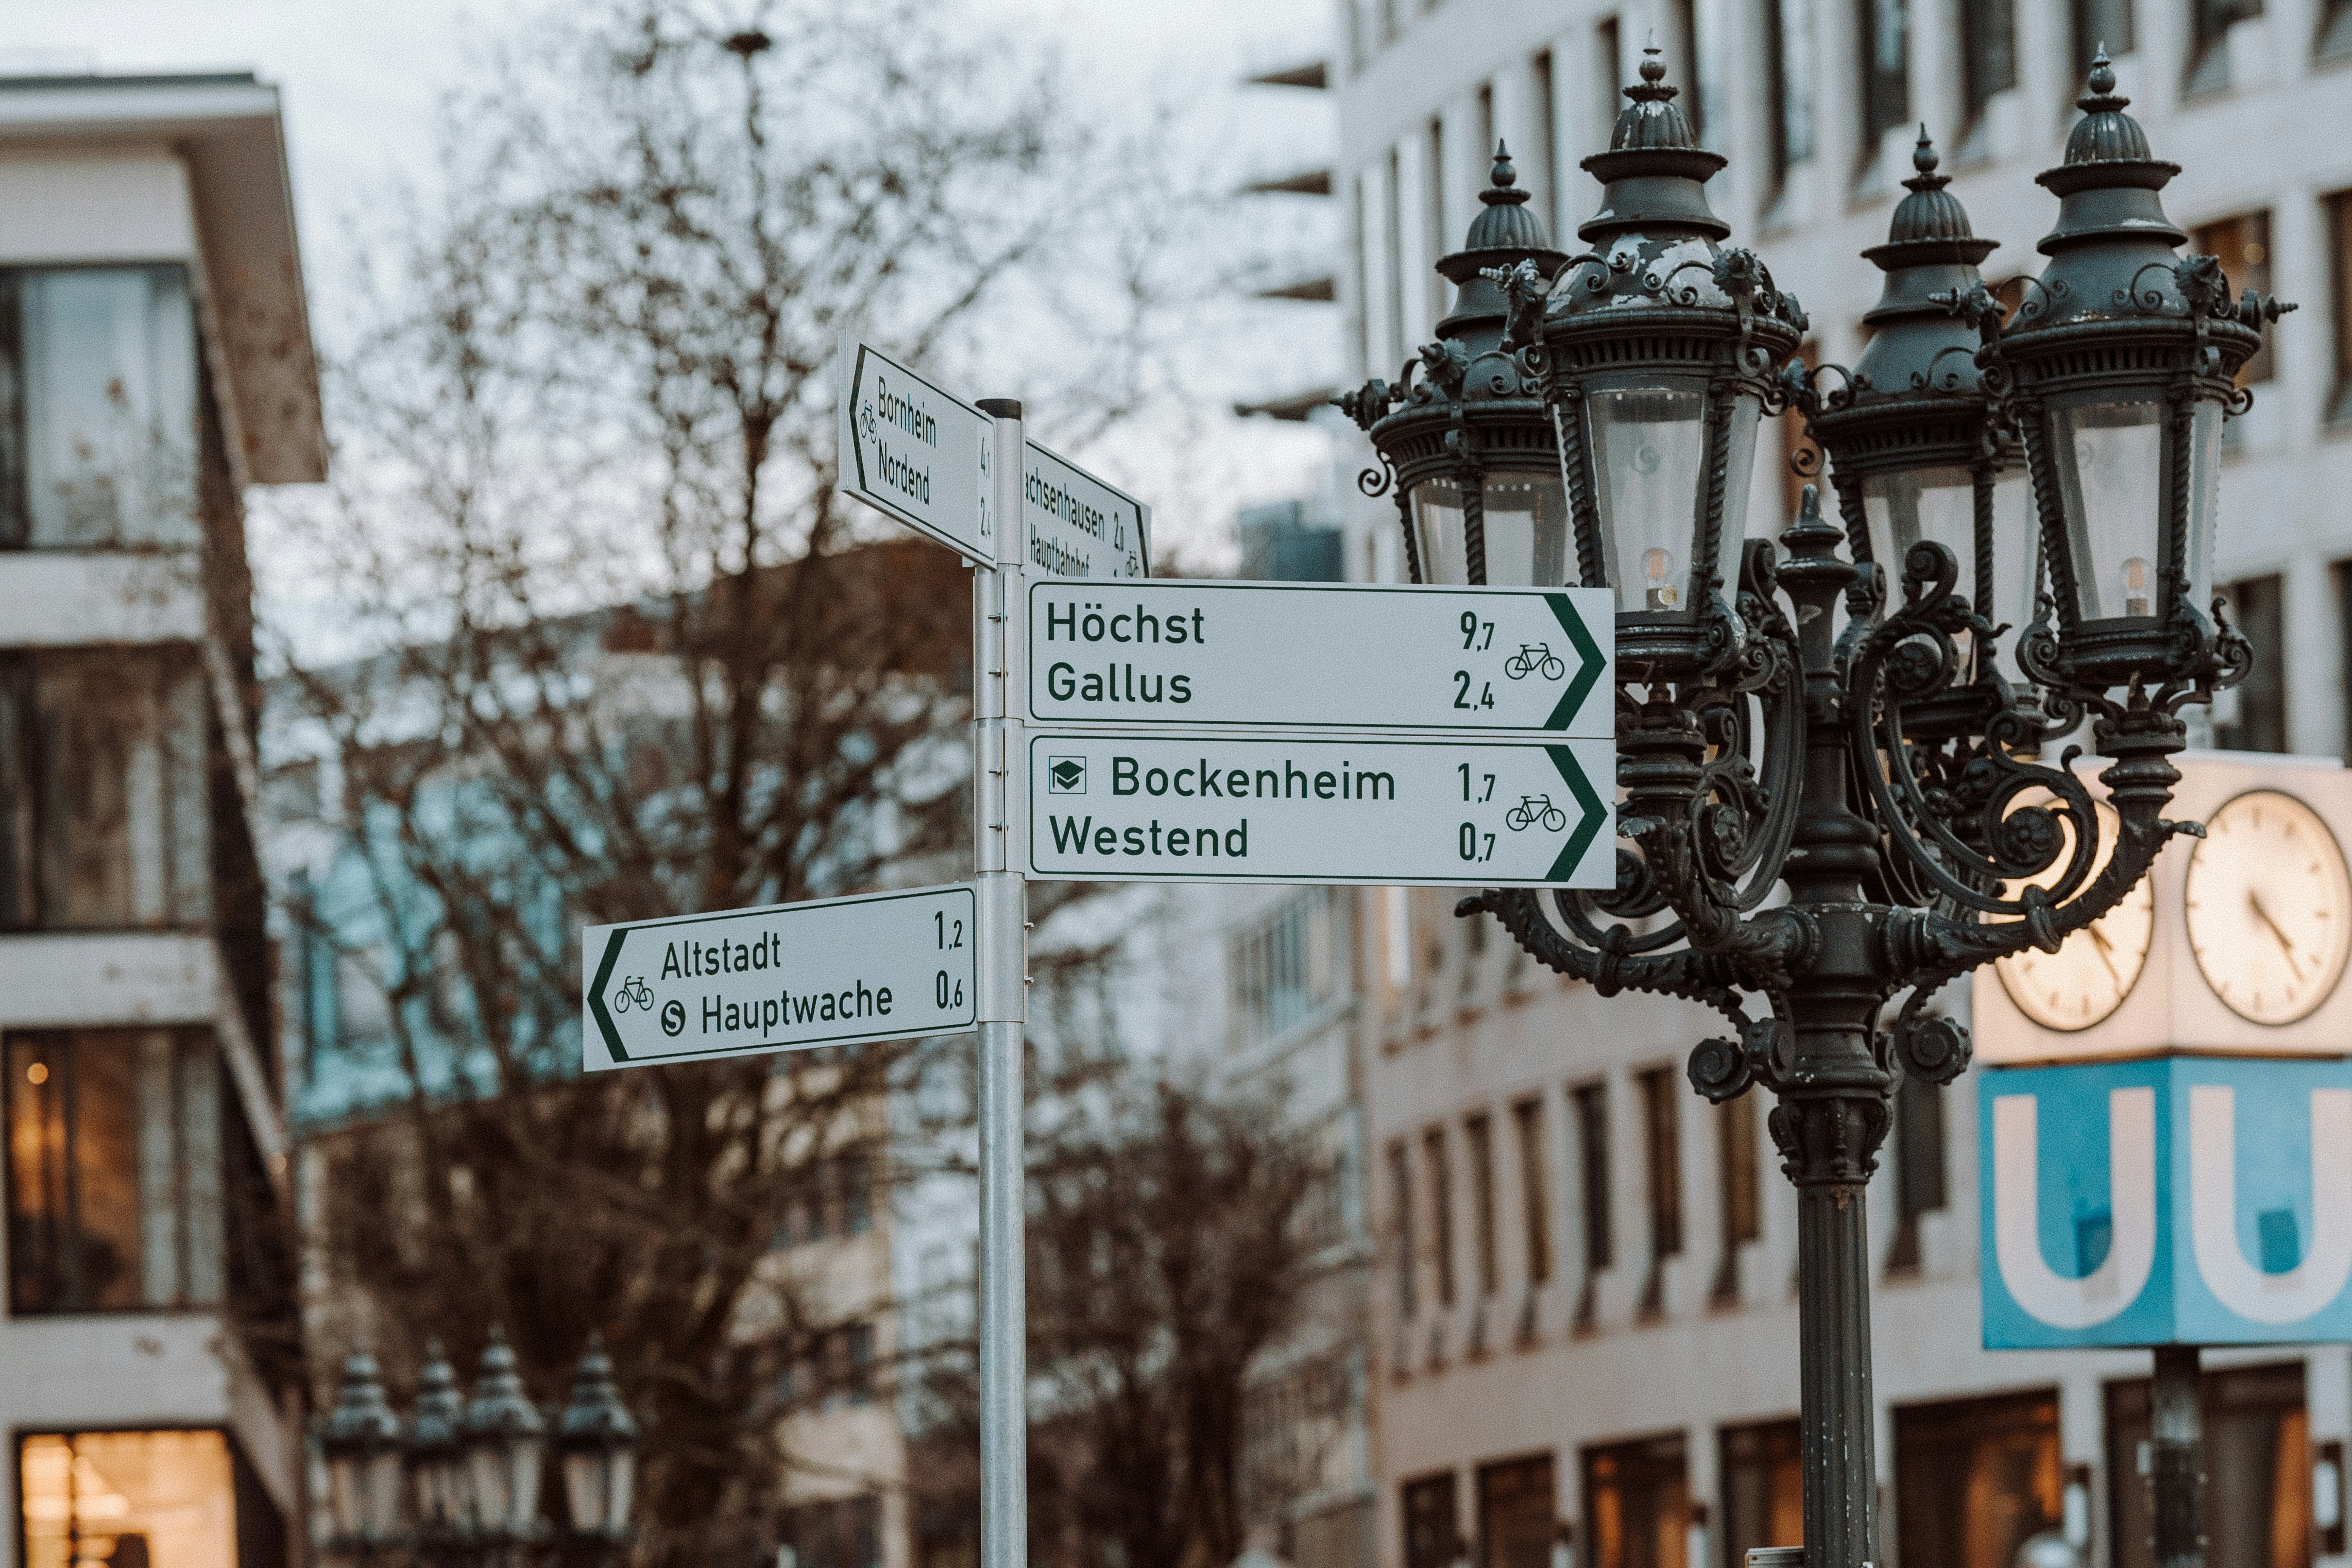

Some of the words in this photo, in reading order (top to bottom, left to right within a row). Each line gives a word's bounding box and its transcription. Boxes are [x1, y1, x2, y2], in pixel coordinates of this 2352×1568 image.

[879, 376, 936, 448] Bornheim
[879, 438, 929, 505] Nordend
[1048, 602, 1204, 644] Höchst
[1460, 611, 1494, 652] 9,7
[1048, 662, 1192, 704] Gallus
[1454, 670, 1494, 711] 2,4
[1113, 757, 1394, 800] Bockenheim
[1458, 763, 1496, 804] 1,7
[1049, 815, 1247, 857] Westend
[1459, 822, 1496, 863] 0,7
[661, 931, 781, 980] Altstadt
[934, 911, 962, 950] 1,2
[703, 980, 892, 1037] Hauptwache
[936, 970, 963, 1010] 0,6
[1993, 1086, 2157, 1329] U
[2189, 1084, 2352, 1325] U
